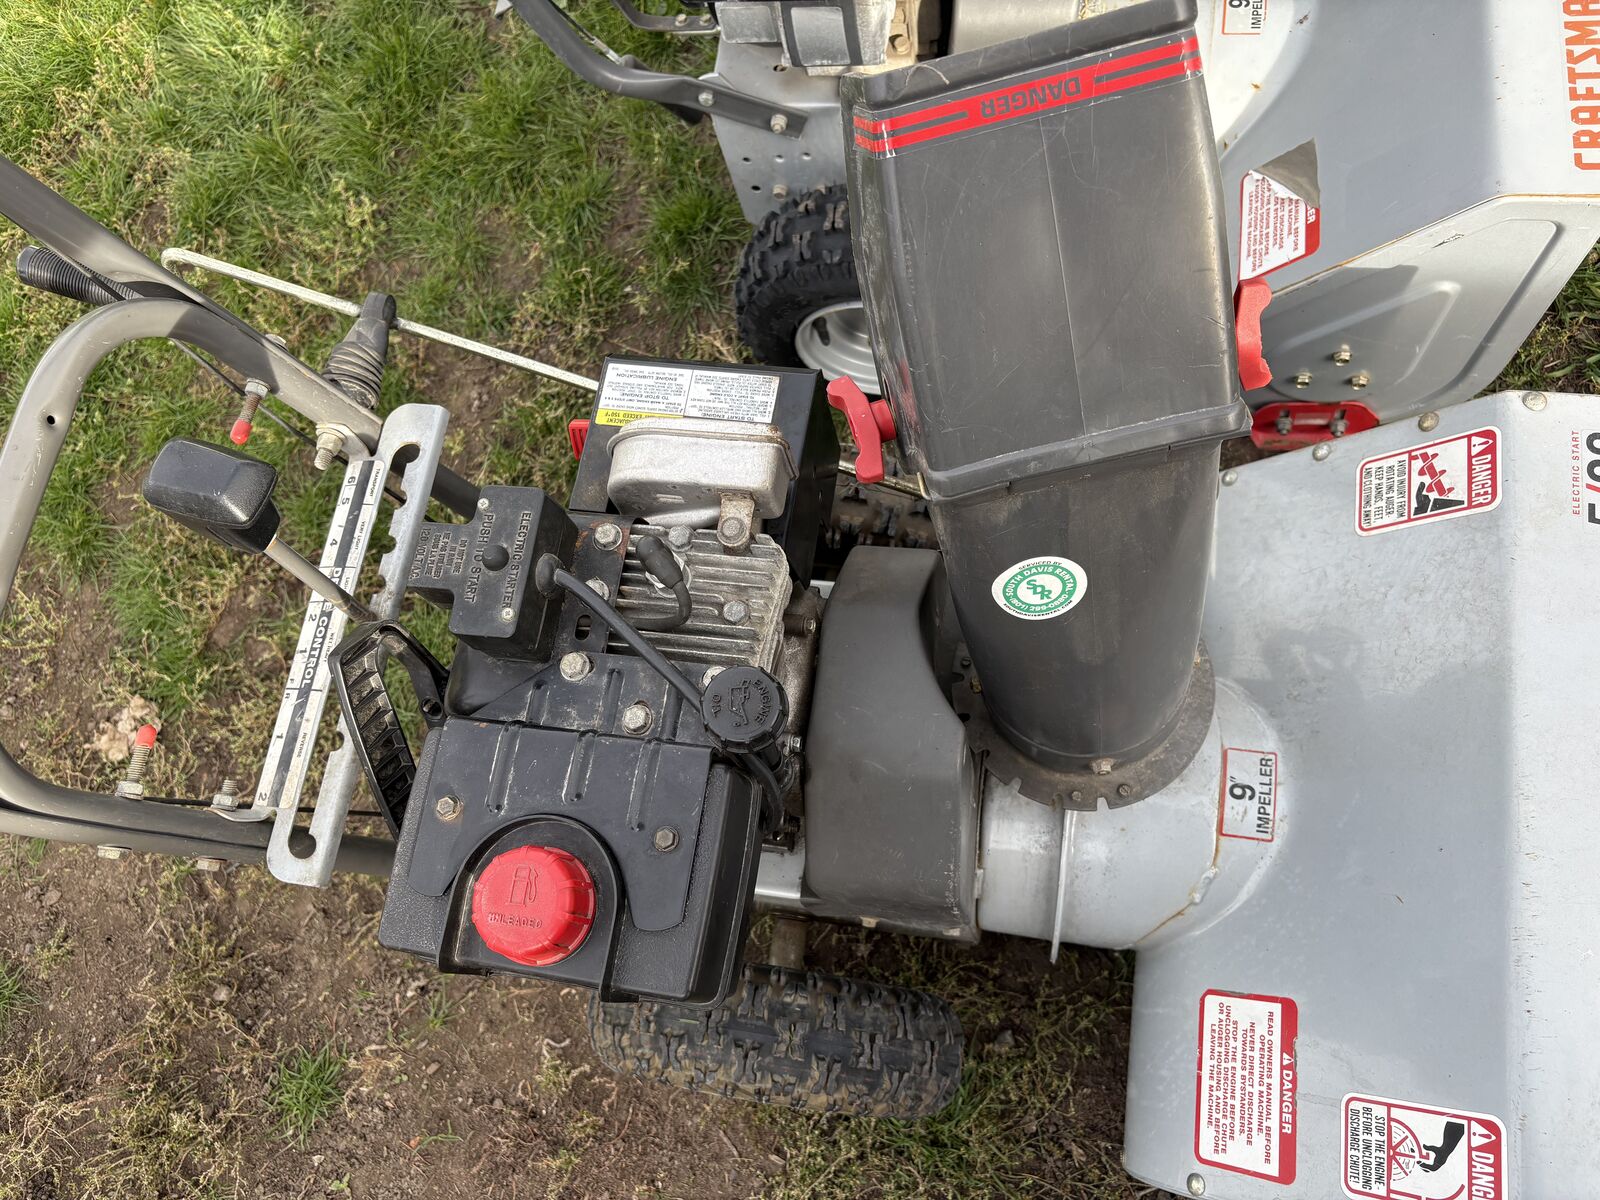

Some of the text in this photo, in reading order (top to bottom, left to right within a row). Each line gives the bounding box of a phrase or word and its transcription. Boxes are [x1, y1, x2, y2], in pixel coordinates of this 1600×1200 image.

[981, 77, 1081, 118] DANGER
[370, 468, 380, 496] TRANSPORT
[1364, 468, 1372, 479] AND
[1385, 465, 1395, 495] ROTATING
[1472, 454, 1492, 506] DANGER
[1363, 480, 1372, 509] CLOTHING
[1373, 466, 1383, 523] KEEP HANDS, FEET,
[1396, 460, 1406, 518] AVOID INJURY FROM
[330, 538, 338, 546] 4
[420, 528, 431, 542] 120
[415, 544, 427, 564] VOLT
[464, 513, 495, 603] PUSH TO START
[502, 511, 532, 608] ELECTRIC STARTER
[1006, 566, 1074, 596] SOUTH DAVIS RENTAL
[1026, 579, 1052, 600] SDR
[301, 616, 328, 688] CONTROL
[712, 694, 721, 718] OIL
[753, 680, 771, 724] ENGINE
[297, 732, 308, 757] REVERSE
[258, 792, 267, 801] 2
[1256, 758, 1273, 834] IMPELLER
[488, 912, 542, 928] UNLEADED
[1218, 1002, 1224, 1014] OR
[1282, 1070, 1293, 1134] DANGER
[1375, 1116, 1385, 1136] STOP
[1350, 1108, 1360, 1184] DISCHARGE CHUTE!
[1362, 1106, 1372, 1190] BEFORE UNCLOGGING
[1375, 1137, 1385, 1151] THE
[1472, 1150, 1494, 1200] DANG
